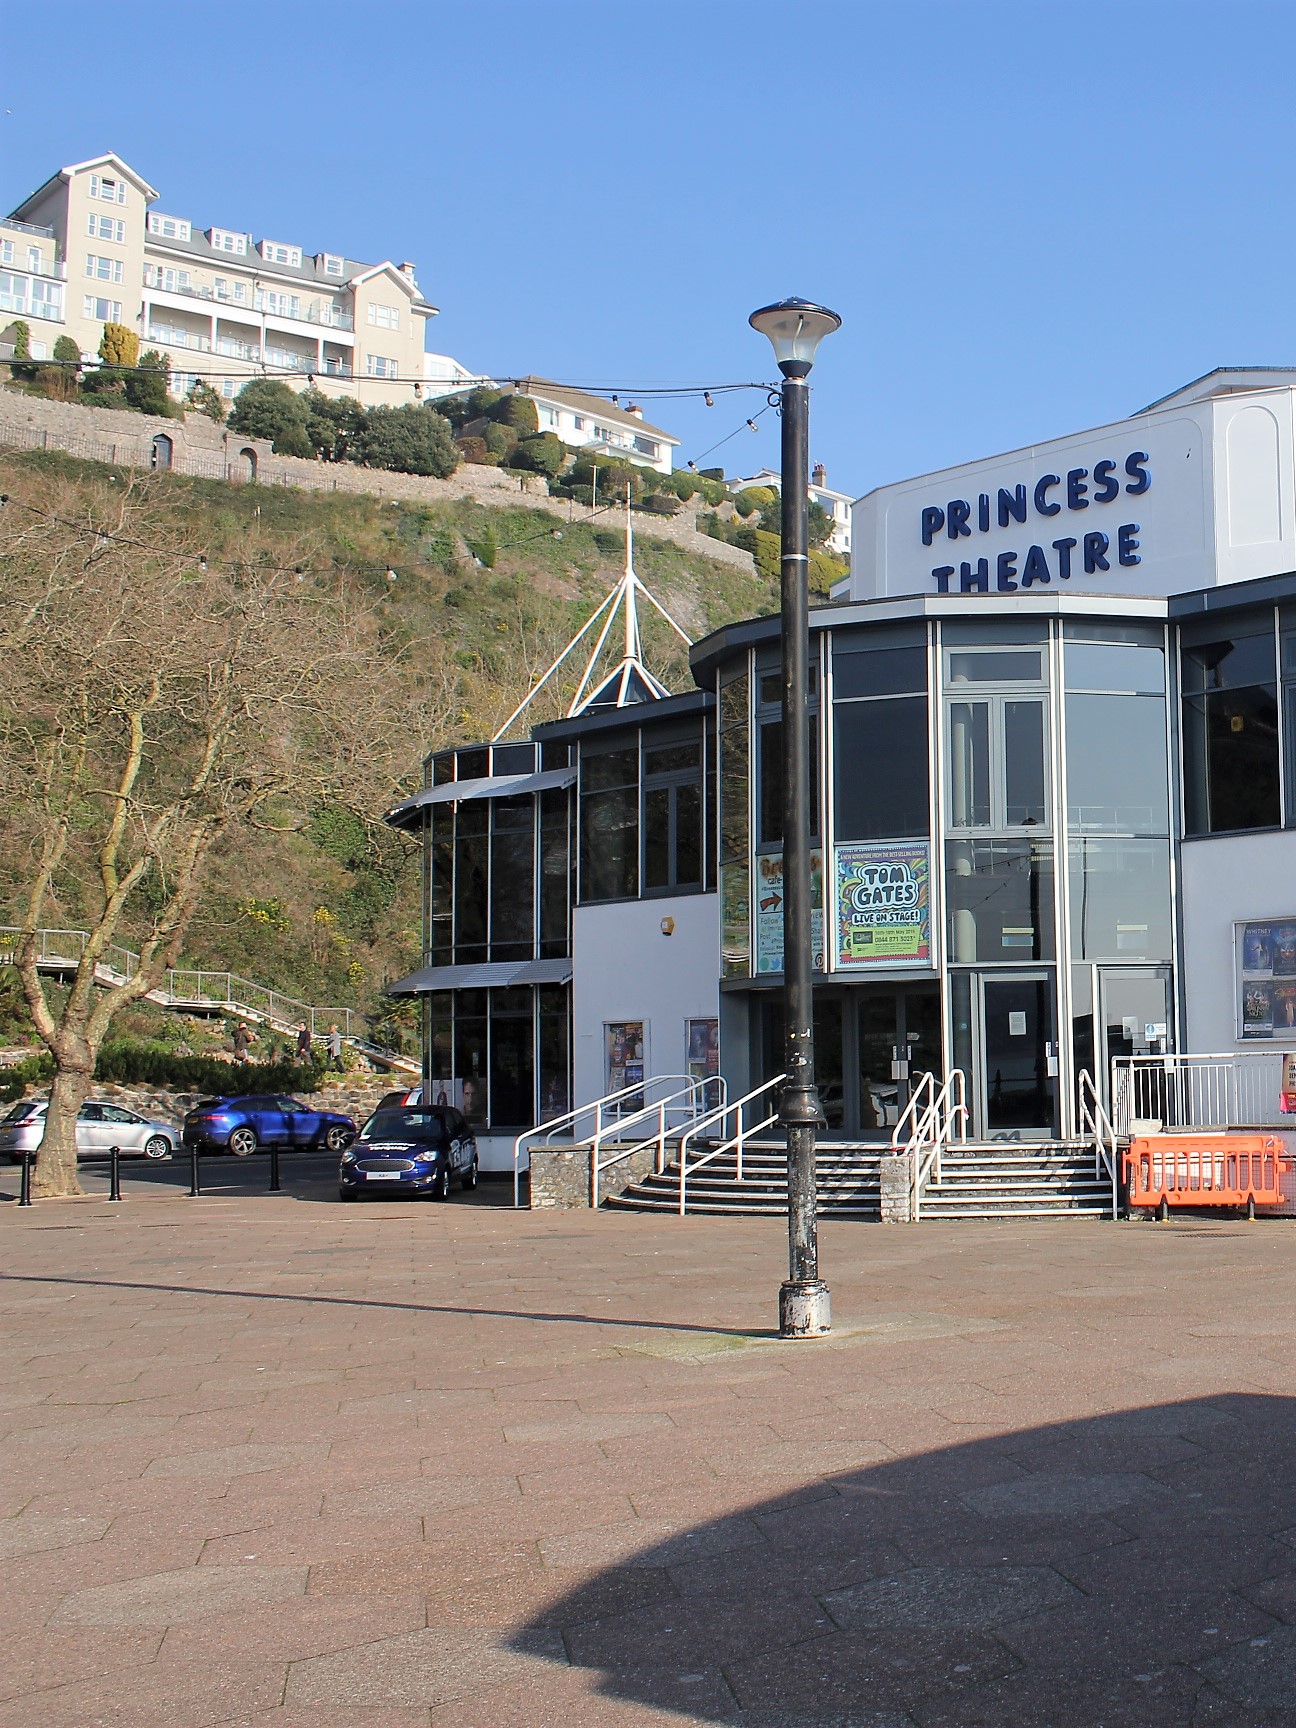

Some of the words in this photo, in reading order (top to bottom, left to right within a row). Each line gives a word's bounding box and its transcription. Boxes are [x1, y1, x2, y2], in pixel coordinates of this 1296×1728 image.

[921, 451, 1151, 546] PRINCESS
[932, 523, 1141, 592] THEATRE
[865, 867, 904, 885] TOM
[858, 884, 914, 905] GATES
[854, 914, 874, 923] LIVE
[877, 913, 887, 922] ON
[890, 911, 918, 921] STAGE!
